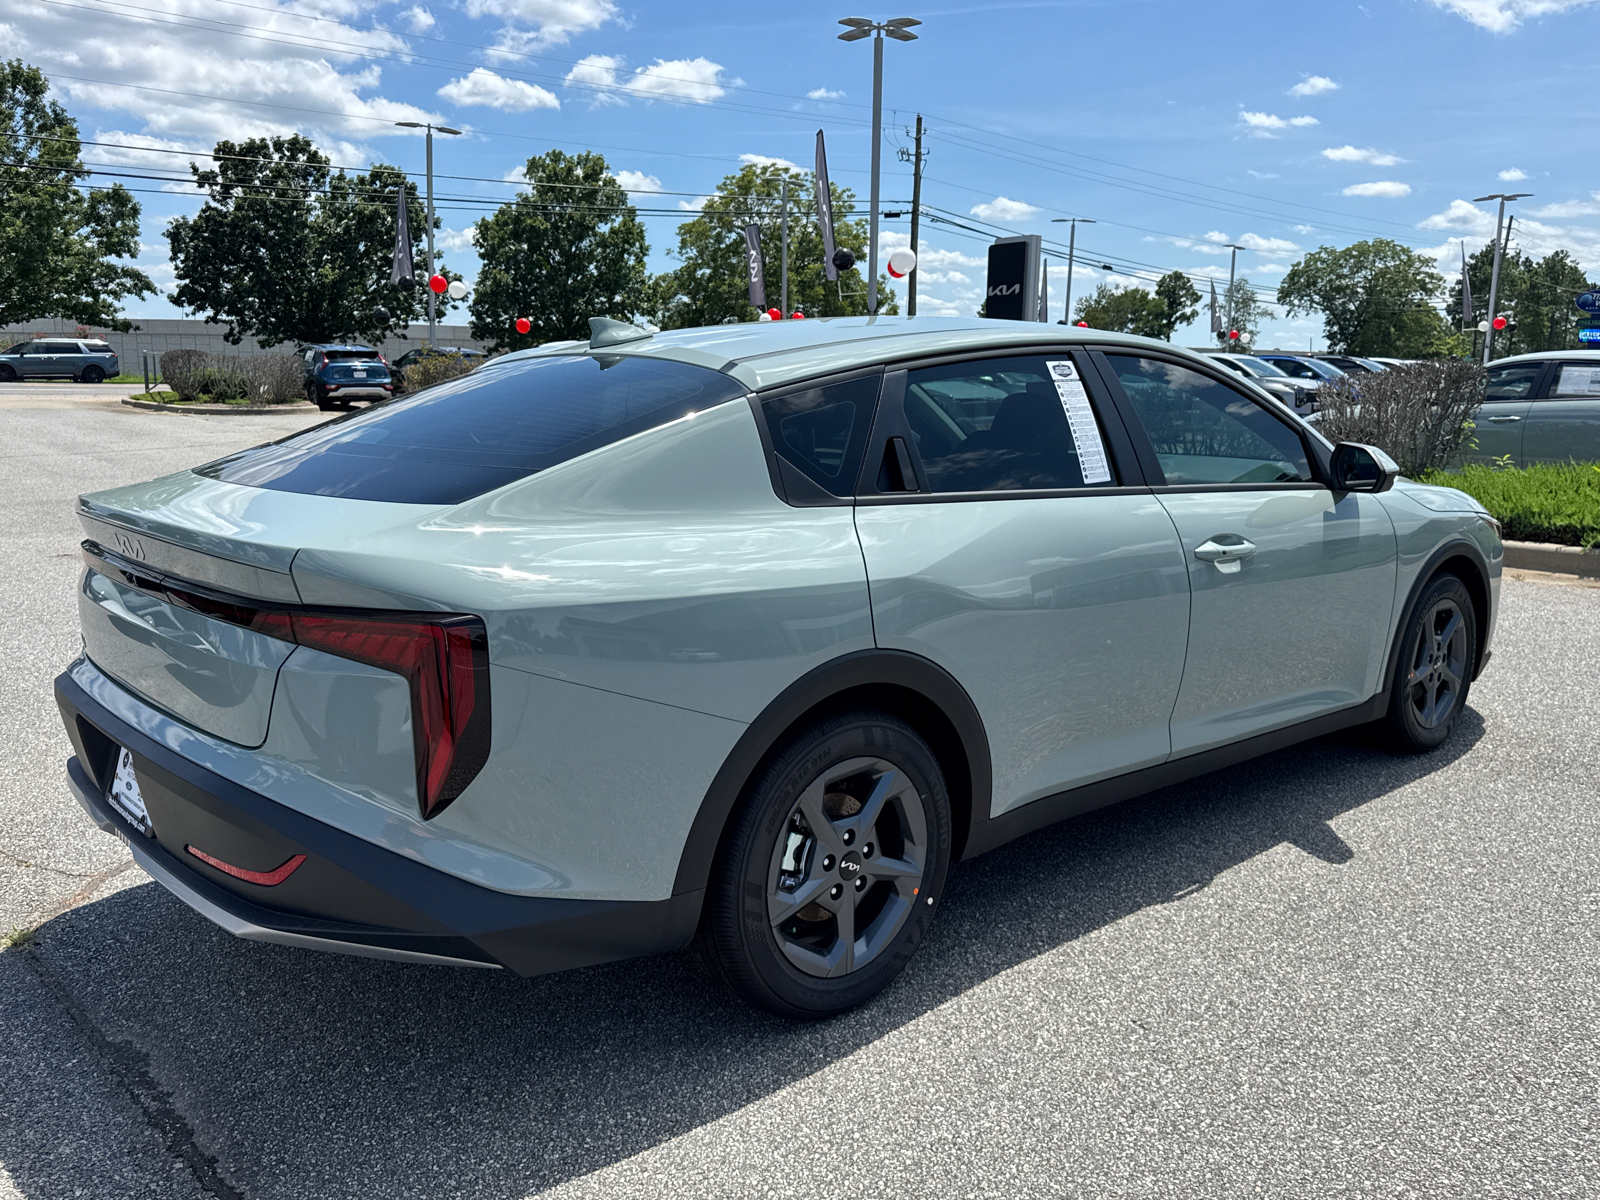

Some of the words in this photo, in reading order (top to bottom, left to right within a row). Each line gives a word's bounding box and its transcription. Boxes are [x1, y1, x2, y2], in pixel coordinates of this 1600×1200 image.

[750, 250, 758, 282] KIA
[988, 284, 1020, 296] KIA
[114, 532, 146, 561] KIA
[1415, 592, 1438, 633] KUMHO
[763, 787, 791, 836] 205/55
[789, 763, 810, 789] R16
[810, 747, 831, 768] 91H
[927, 770, 949, 850] KUMHO
[840, 860, 860, 872] KIA
